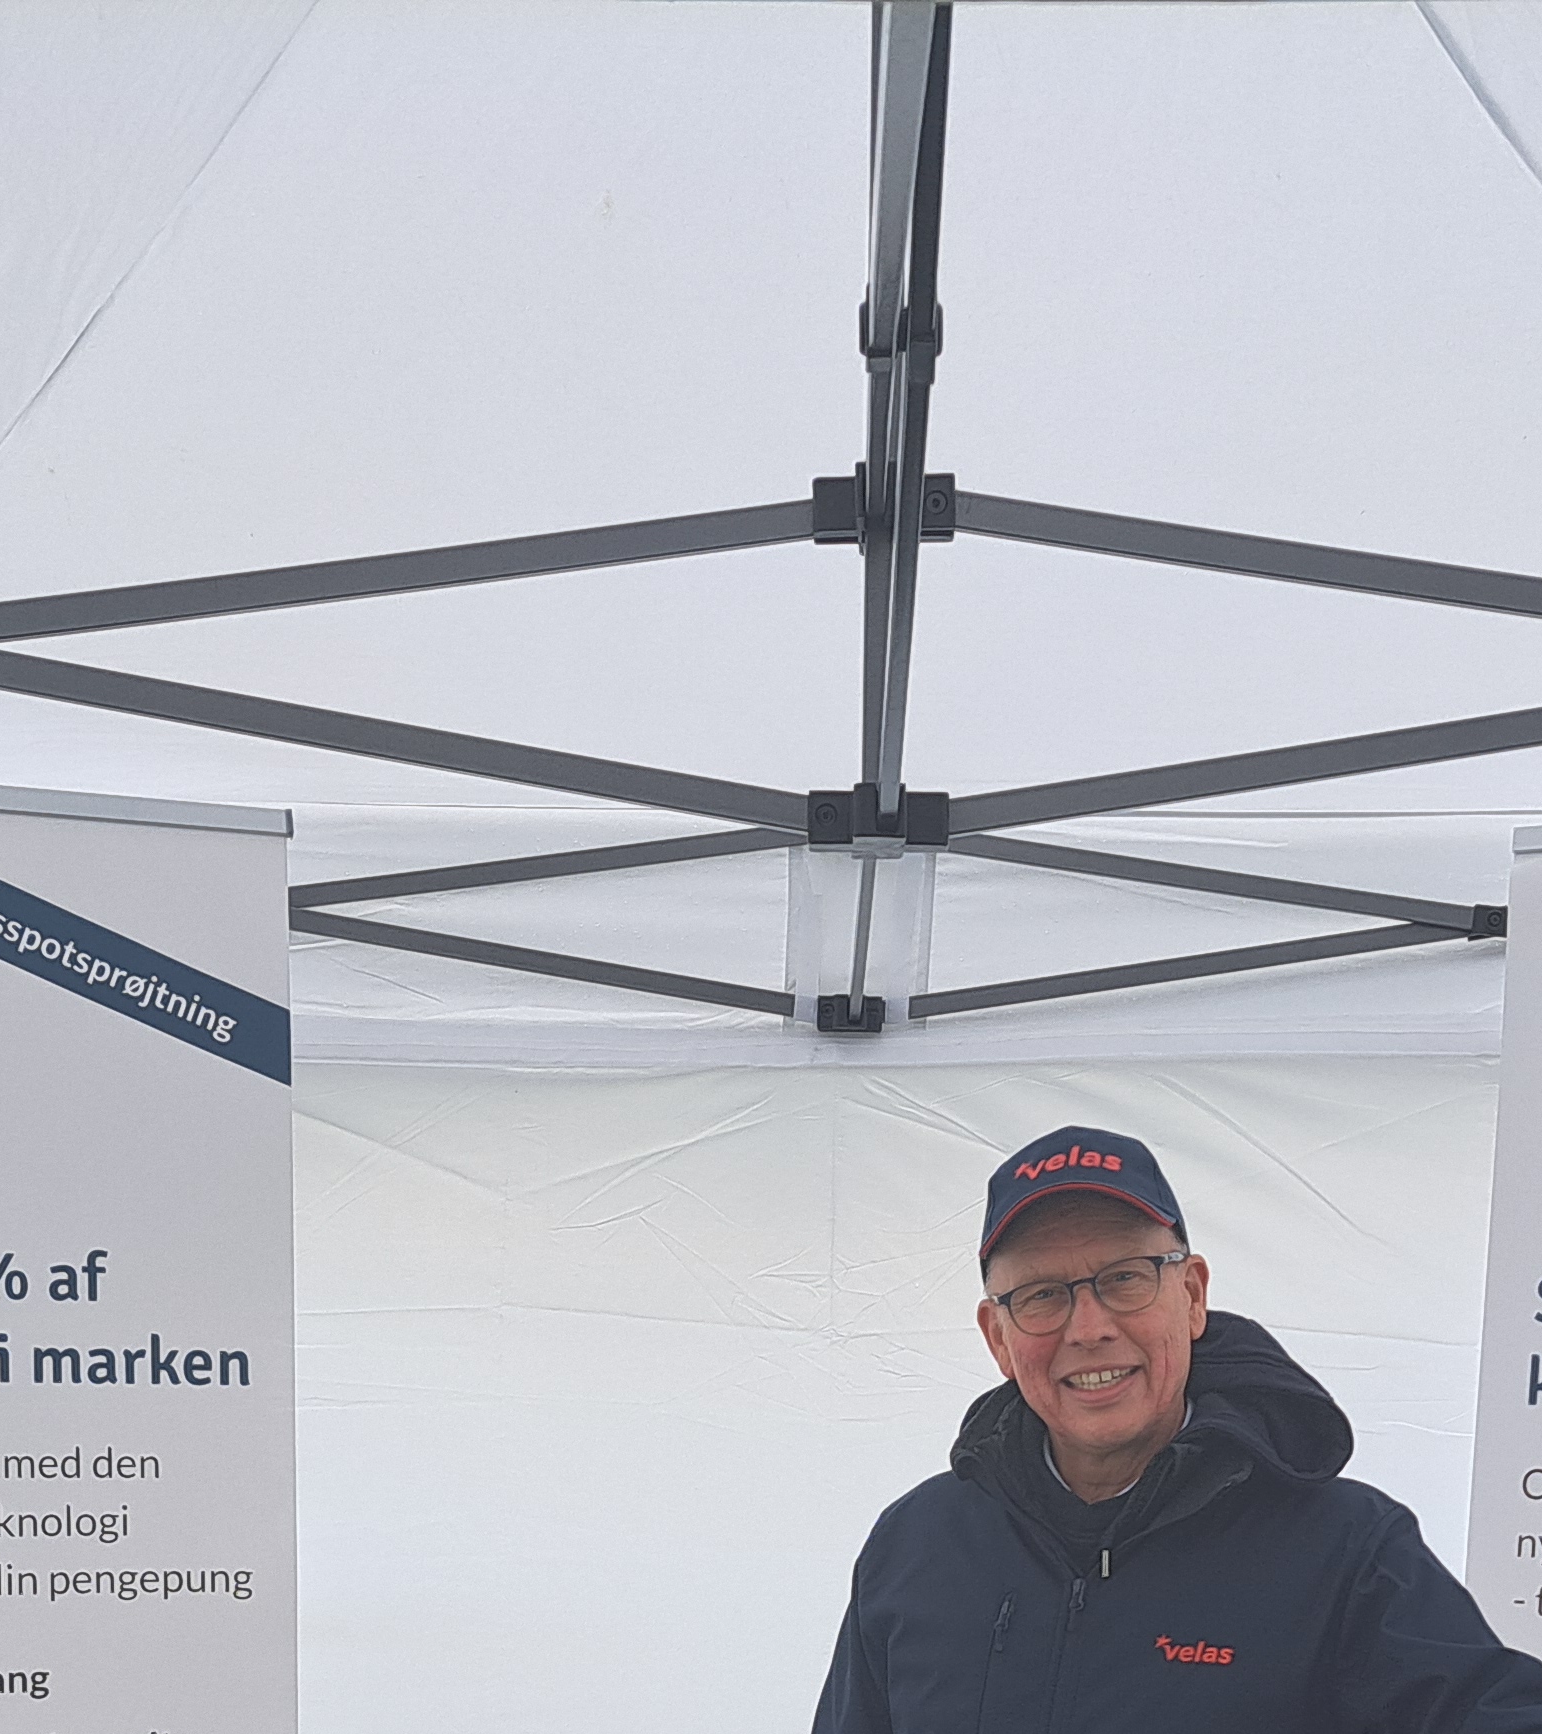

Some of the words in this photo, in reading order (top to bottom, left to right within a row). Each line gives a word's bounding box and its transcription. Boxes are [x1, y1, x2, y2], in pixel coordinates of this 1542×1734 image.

[1025, 1144, 1122, 1180] velas
[48, 1249, 108, 1302] af
[33, 1333, 250, 1387] marken
[4, 1446, 81, 1479] med
[92, 1446, 160, 1479] den
[50, 1570, 253, 1602] pengepung
[1164, 1641, 1234, 1665] velas
